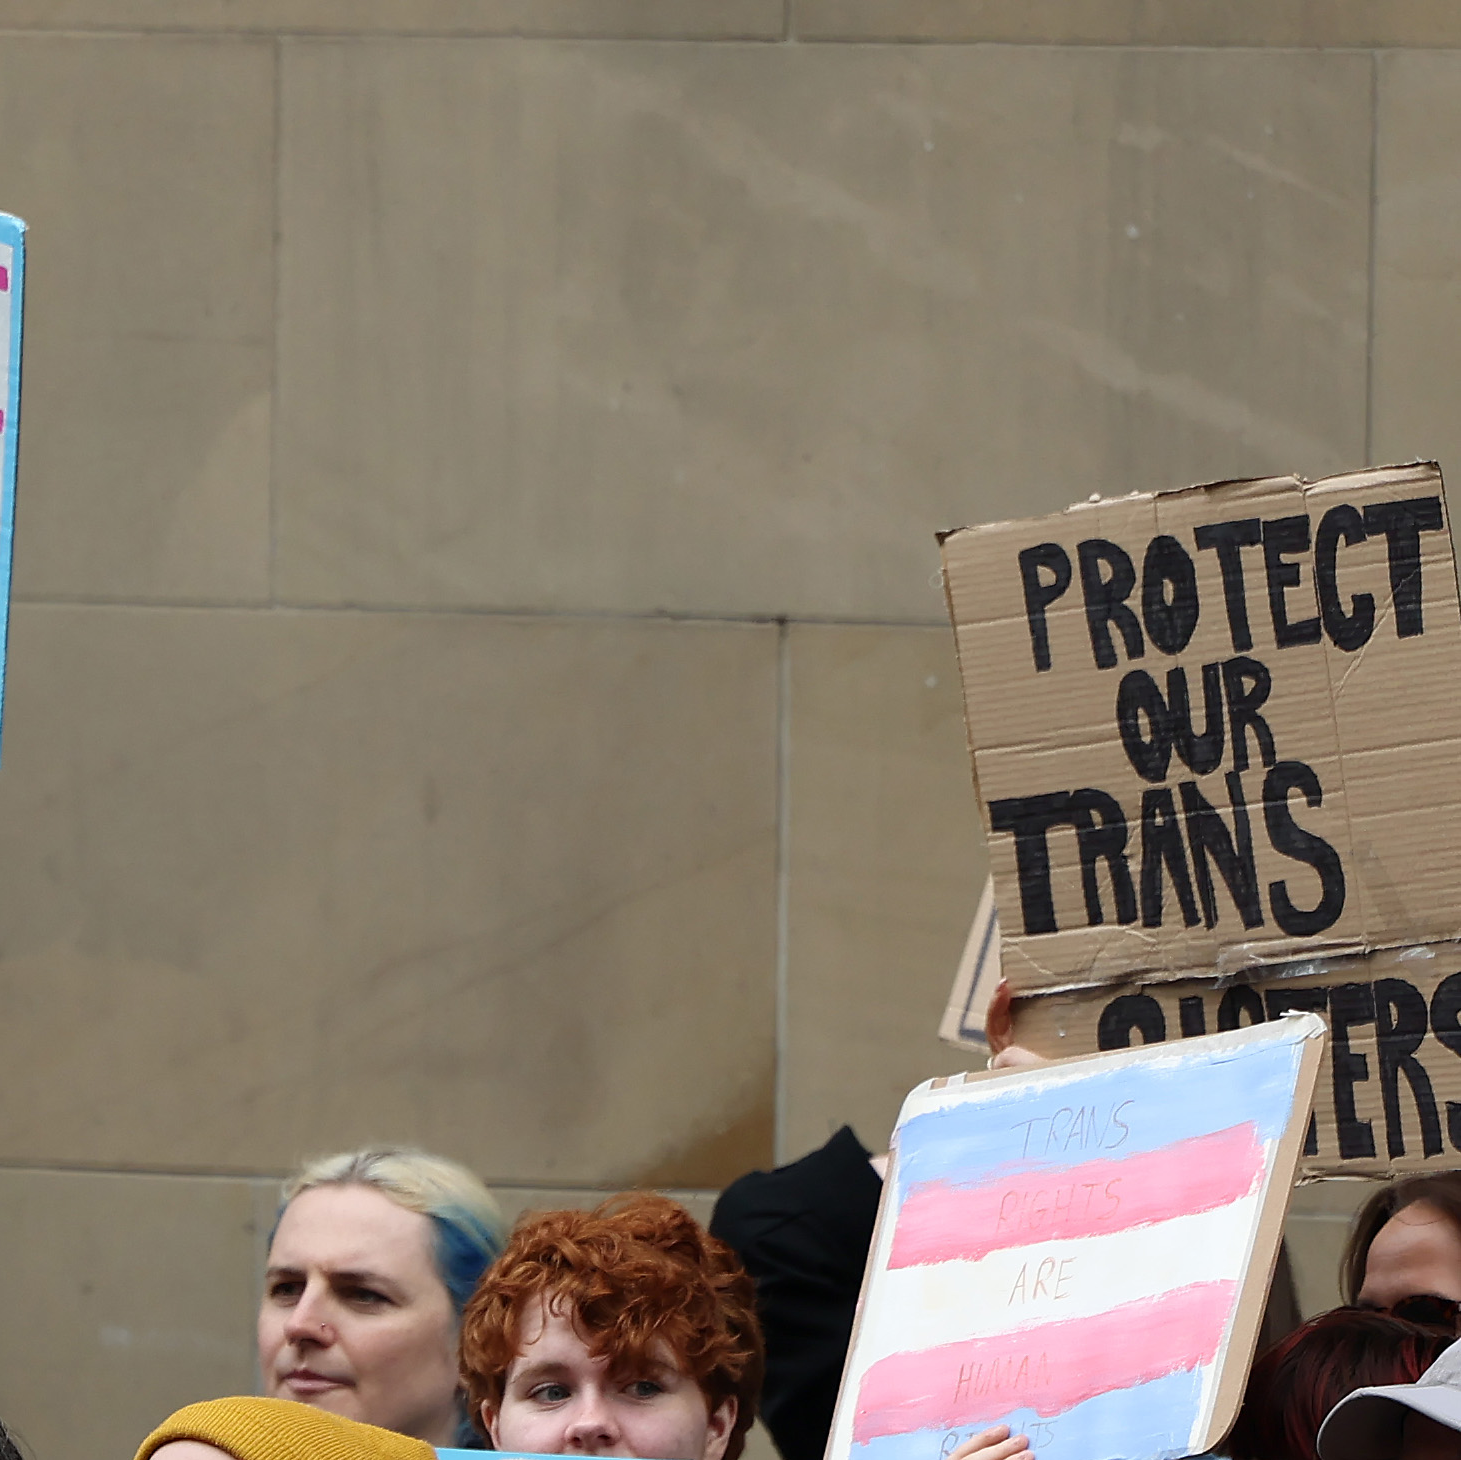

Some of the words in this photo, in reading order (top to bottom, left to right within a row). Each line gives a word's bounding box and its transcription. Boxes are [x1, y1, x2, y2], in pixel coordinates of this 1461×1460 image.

[1018, 496, 1443, 673] PROTECT
[1115, 656, 1278, 784] OUR
[986, 760, 1345, 938] TRANS
[1011, 1100, 1135, 1159] TRANS
[996, 1178, 1122, 1235] RIGHTS
[1008, 1256, 1079, 1306] ARE
[953, 1352, 1052, 1404] HUMAN
